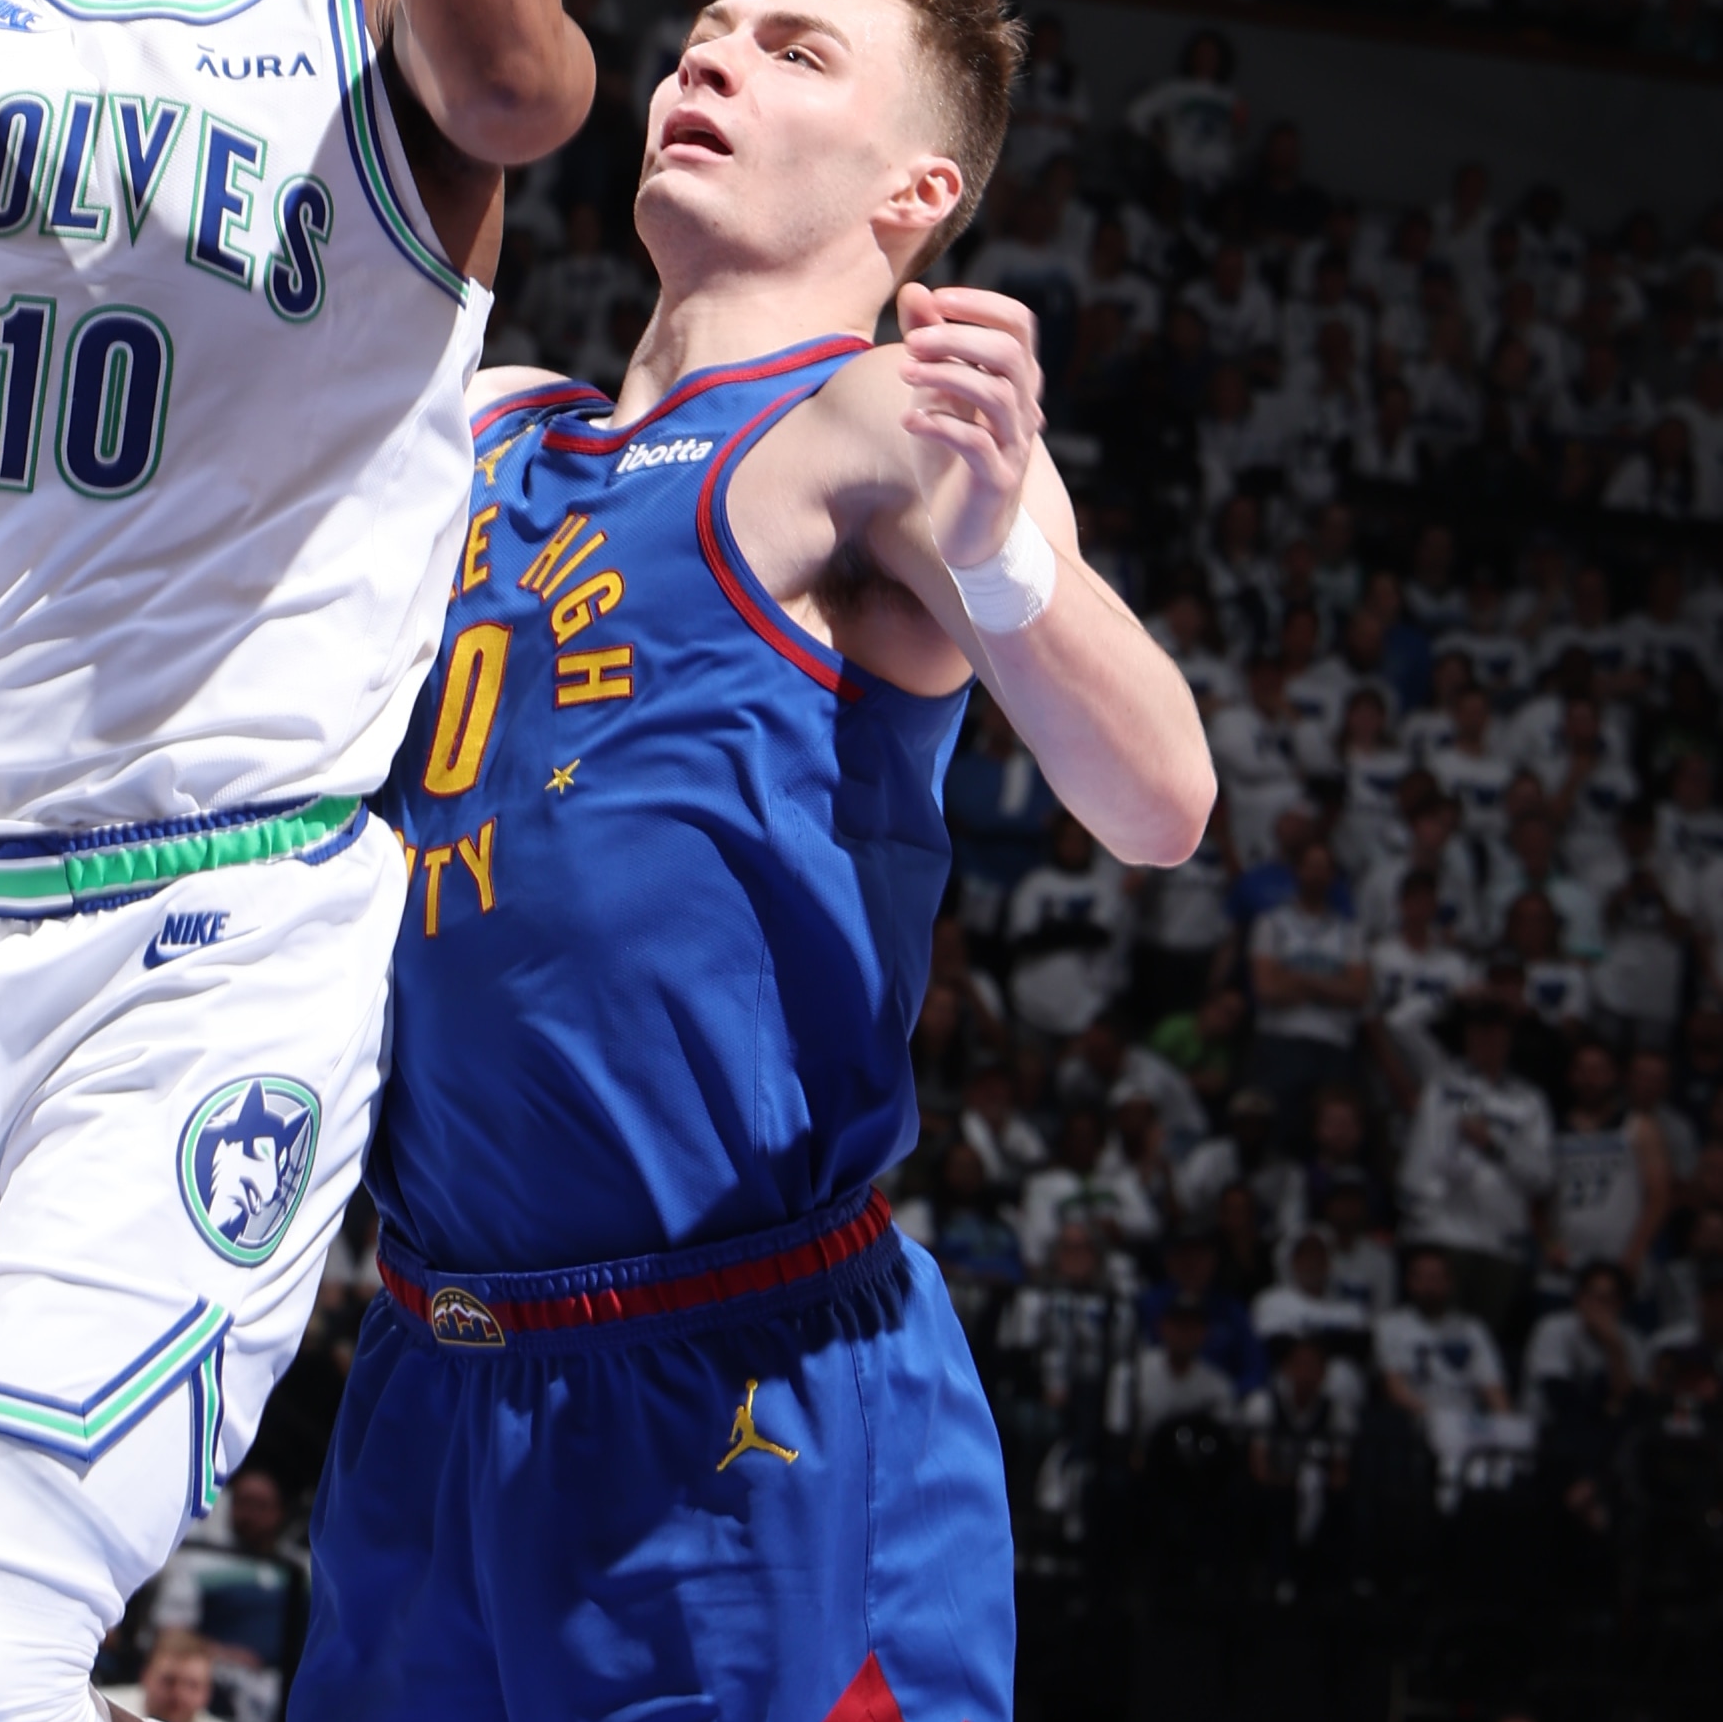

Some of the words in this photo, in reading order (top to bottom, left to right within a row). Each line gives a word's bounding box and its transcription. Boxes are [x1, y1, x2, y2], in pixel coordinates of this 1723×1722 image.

[615, 437, 715, 475] ibotta
[516, 511, 635, 709] HIGH
[159, 908, 232, 947] NIKE
